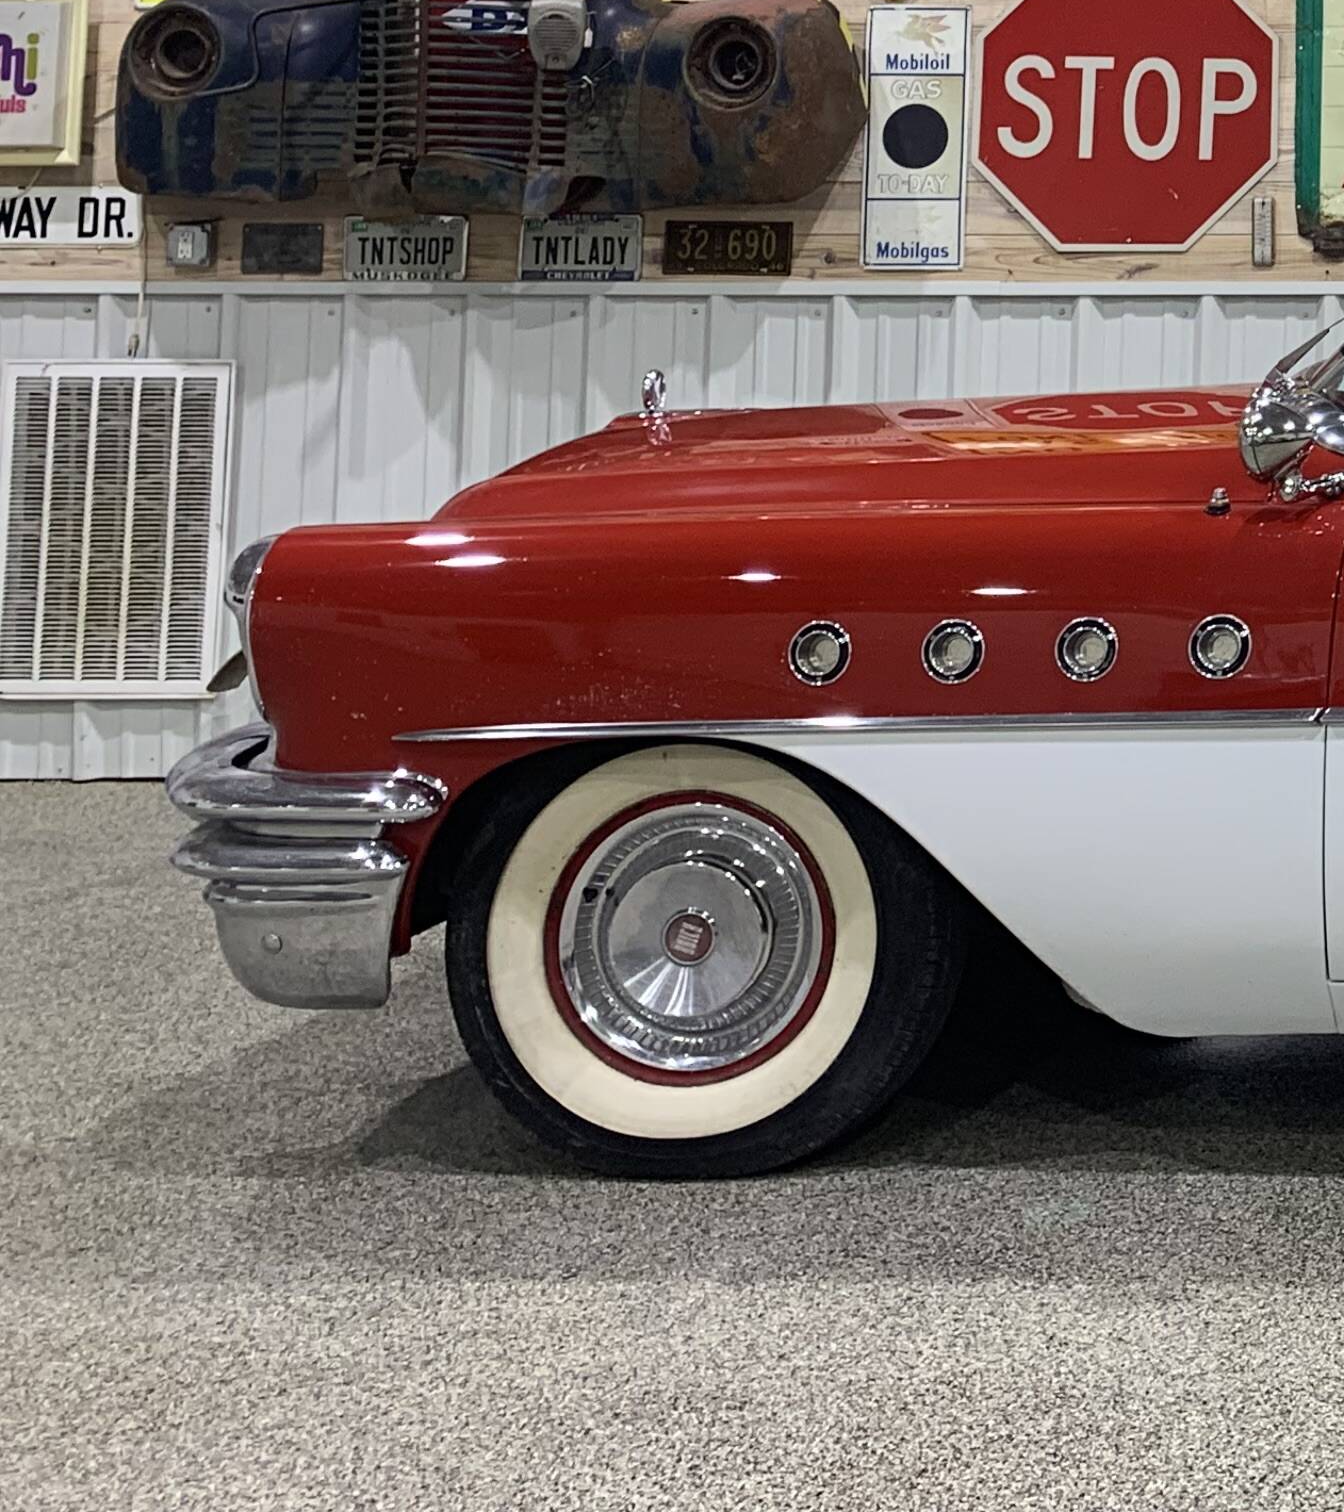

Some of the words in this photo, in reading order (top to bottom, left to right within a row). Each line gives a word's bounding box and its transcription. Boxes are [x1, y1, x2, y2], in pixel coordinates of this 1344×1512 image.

[885, 52, 951, 71] Mobiloil
[892, 78, 942, 99] GAS
[997, 55, 1258, 162] STOP
[78, 197, 133, 239] DR.
[358, 237, 454, 266] TNTSHOP
[532, 237, 629, 266] TNTLADY
[876, 242, 949, 263] Mobilgas
